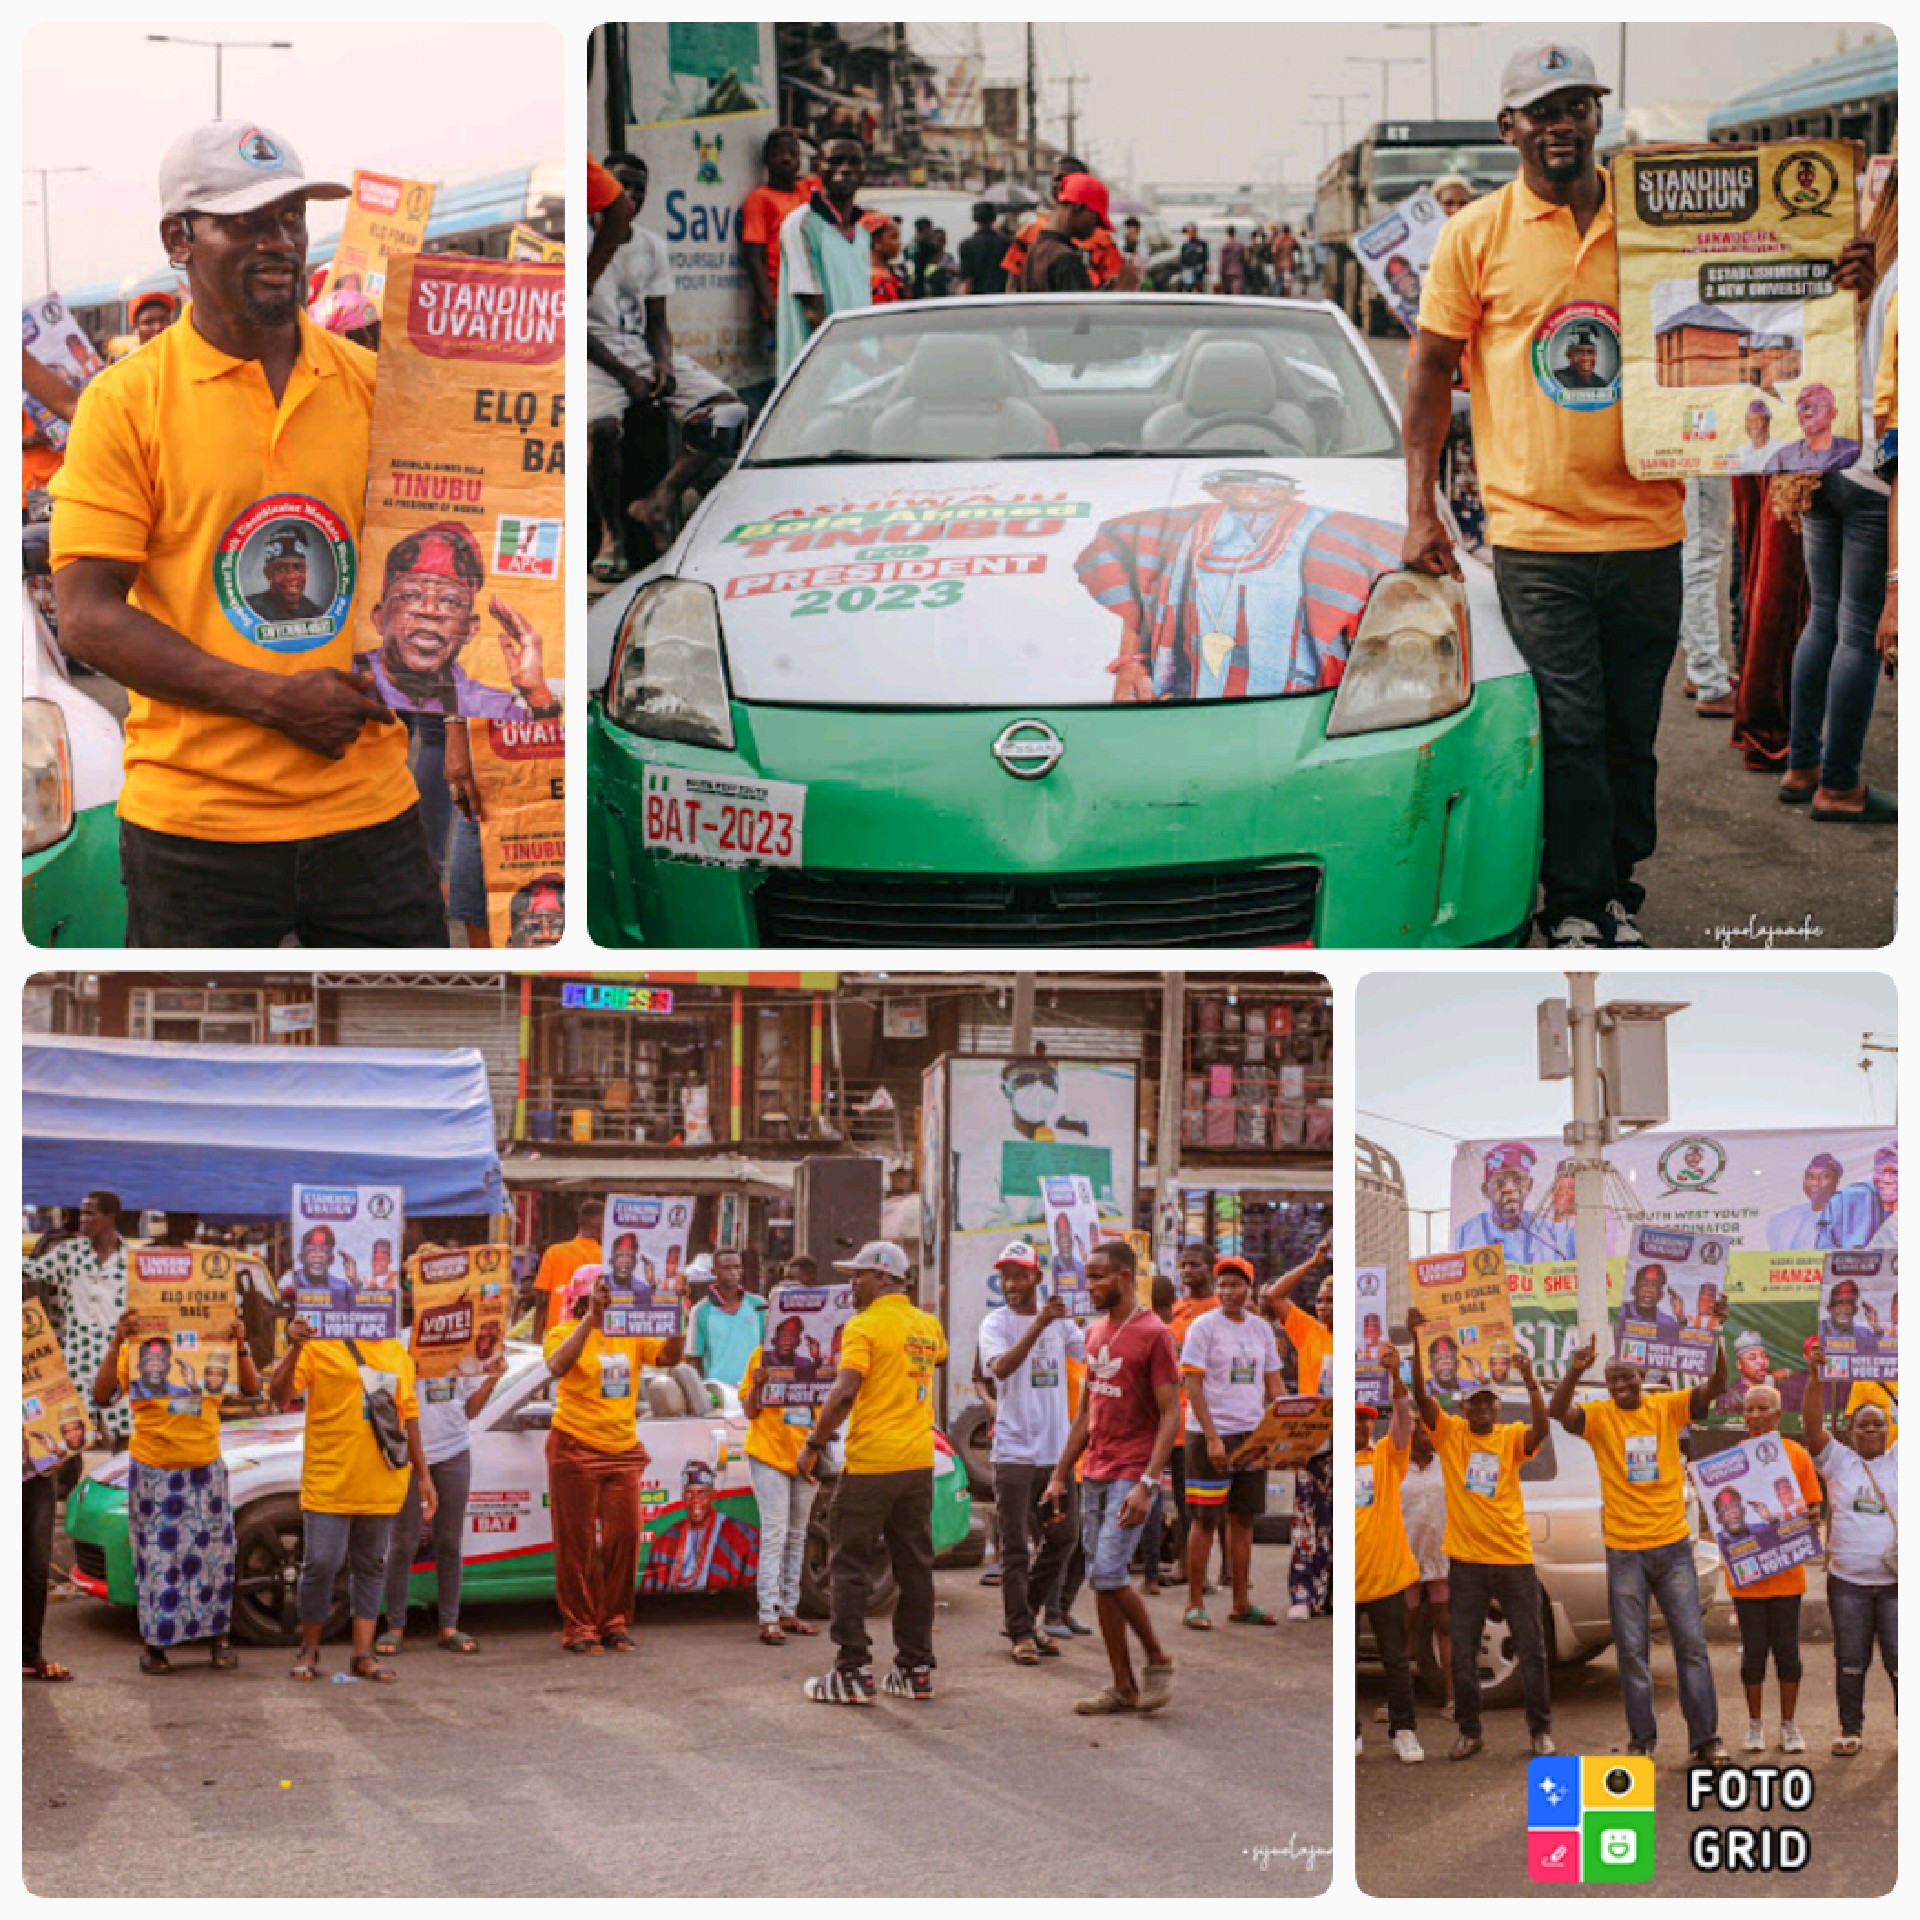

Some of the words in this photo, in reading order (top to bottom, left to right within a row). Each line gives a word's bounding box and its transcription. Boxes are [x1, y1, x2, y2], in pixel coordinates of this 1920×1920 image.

[1638, 166, 1753, 192] STANDING
[418, 280, 565, 318] STANDING
[1716, 282, 1745, 297] NEW
[391, 471, 482, 502] TINUBU
[733, 556, 1039, 599] PRESIDENT
[789, 579, 966, 618] 2023
[647, 794, 794, 858] BAT-2023
[1674, 1209, 1711, 1220] WEST
[1713, 1207, 1760, 1219] YOUTH
[324, 1322, 357, 1338] VOTE
[360, 1322, 388, 1338] APC
[422, 1308, 471, 1334] VOTE!
[1647, 1354, 1679, 1369] VOTE
[1680, 1357, 1705, 1373] APC
[1852, 1367, 1880, 1378] VOTE
[1762, 1556, 1792, 1575] VOTE
[1793, 1547, 1817, 1563] APC
